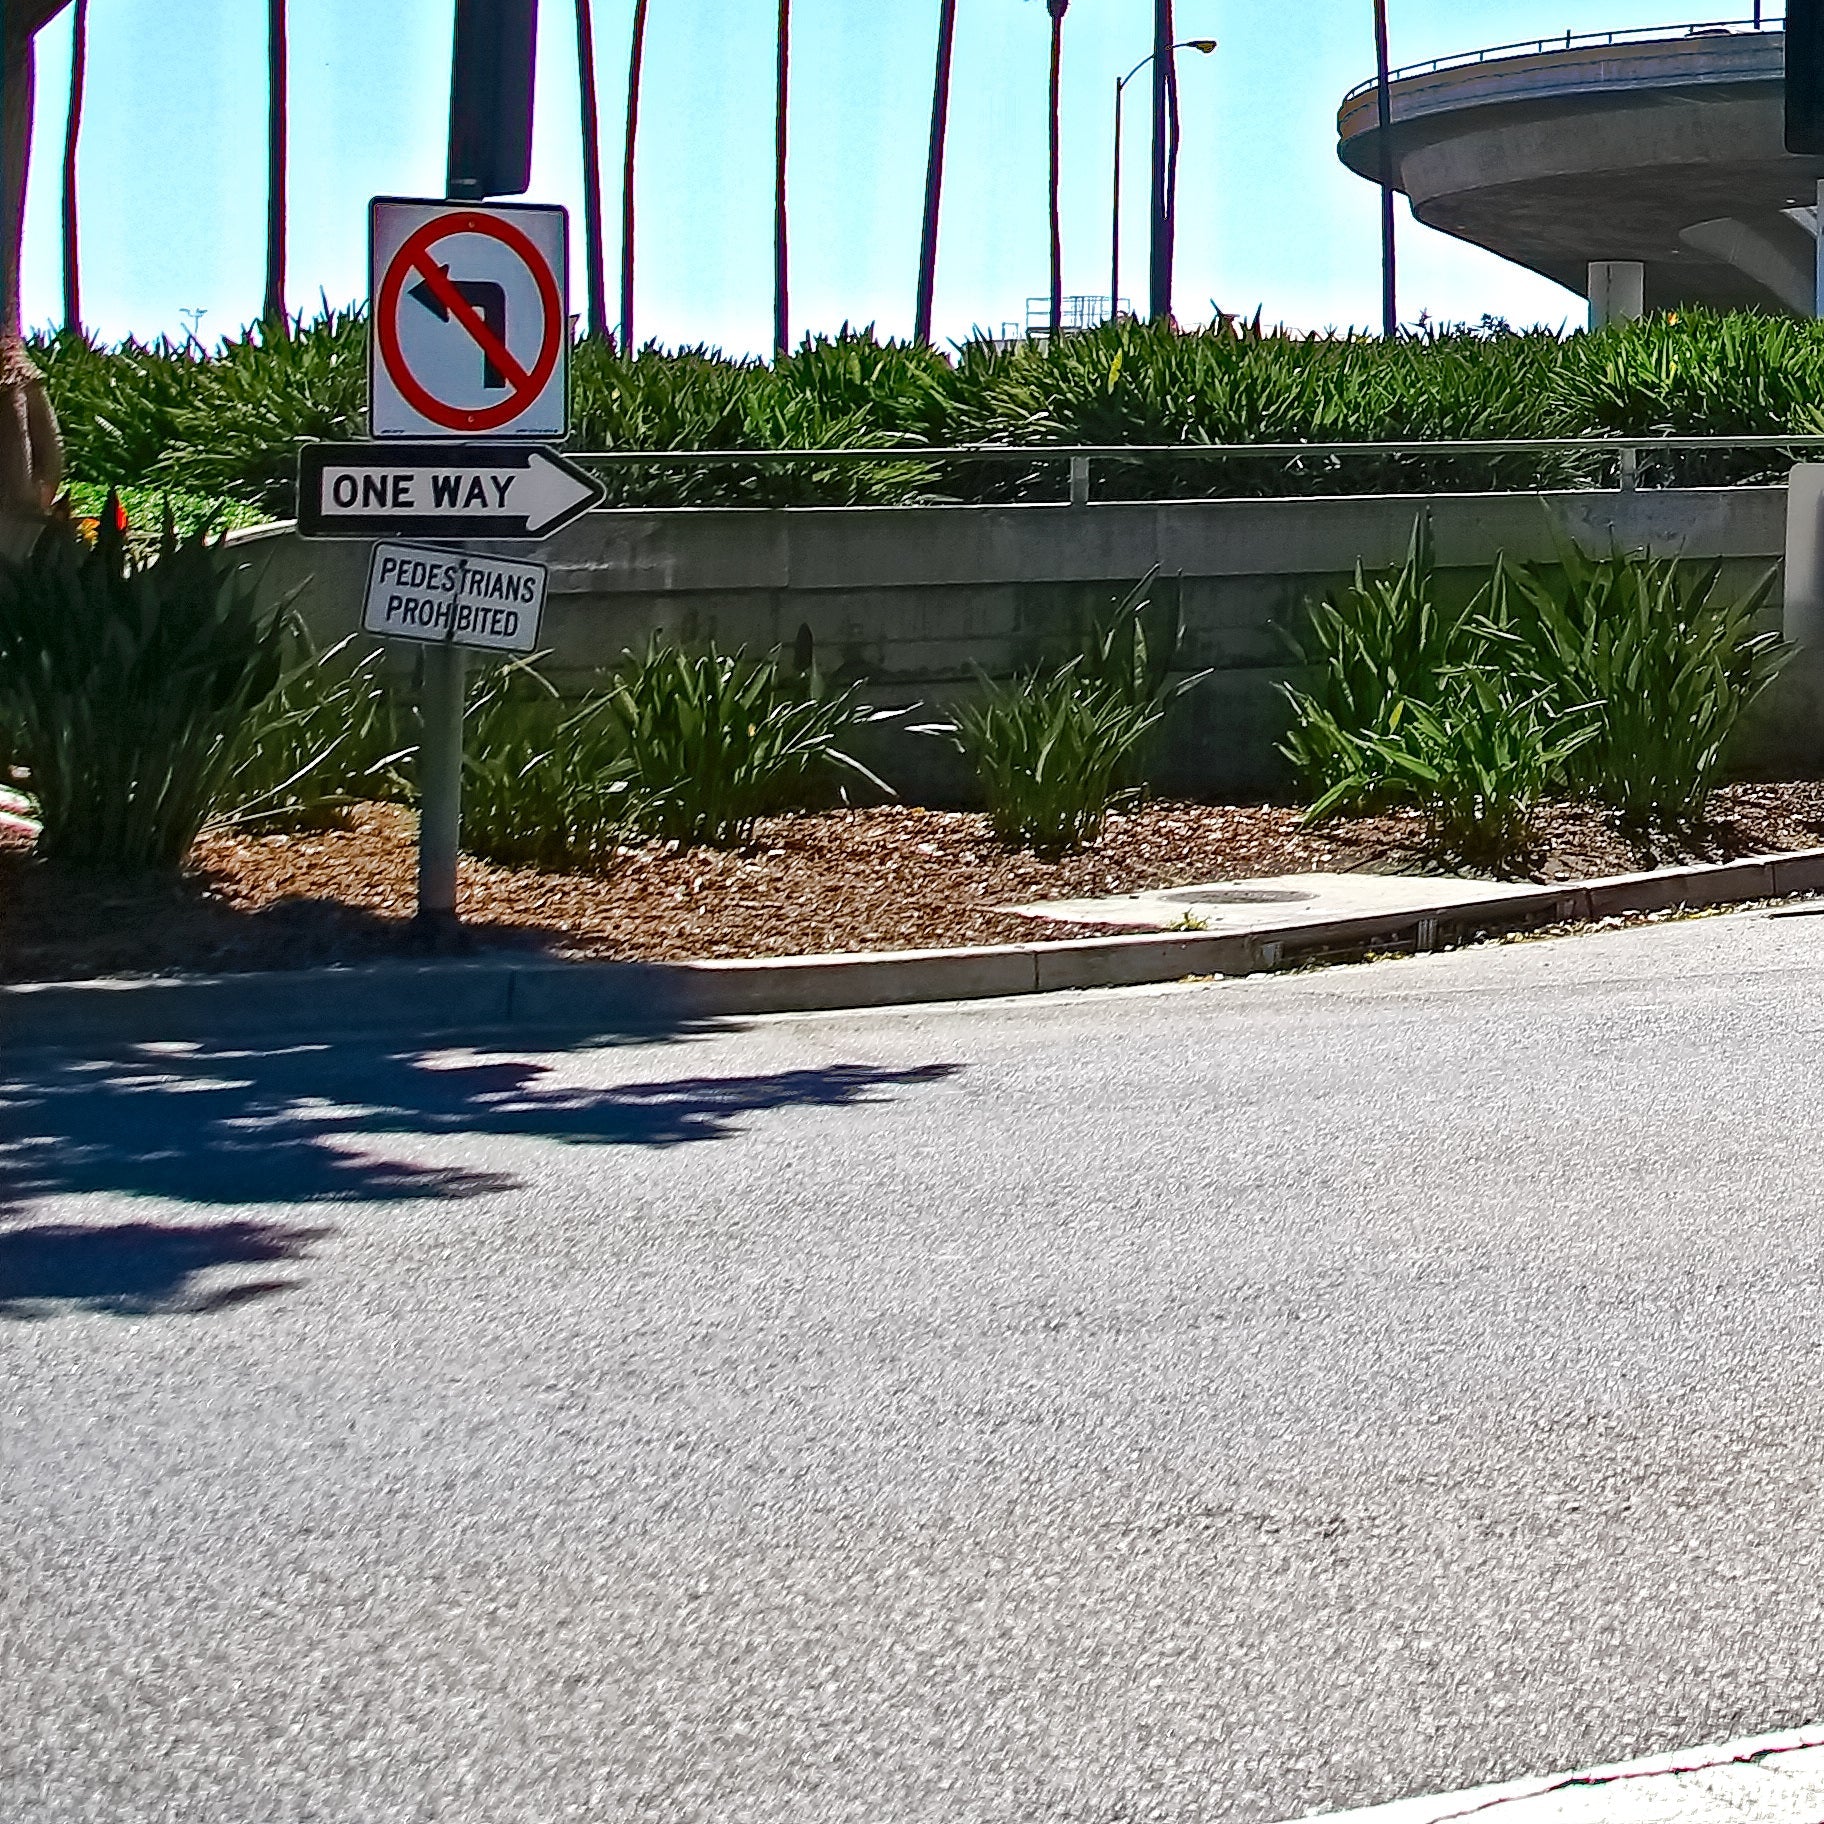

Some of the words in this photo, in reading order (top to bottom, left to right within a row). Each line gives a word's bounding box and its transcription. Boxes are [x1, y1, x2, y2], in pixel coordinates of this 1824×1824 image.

[332, 473, 416, 509] ONE
[432, 476, 516, 510] WAY
[379, 557, 536, 604] PEDESTRIANS
[386, 596, 519, 637] PROHIBITED
